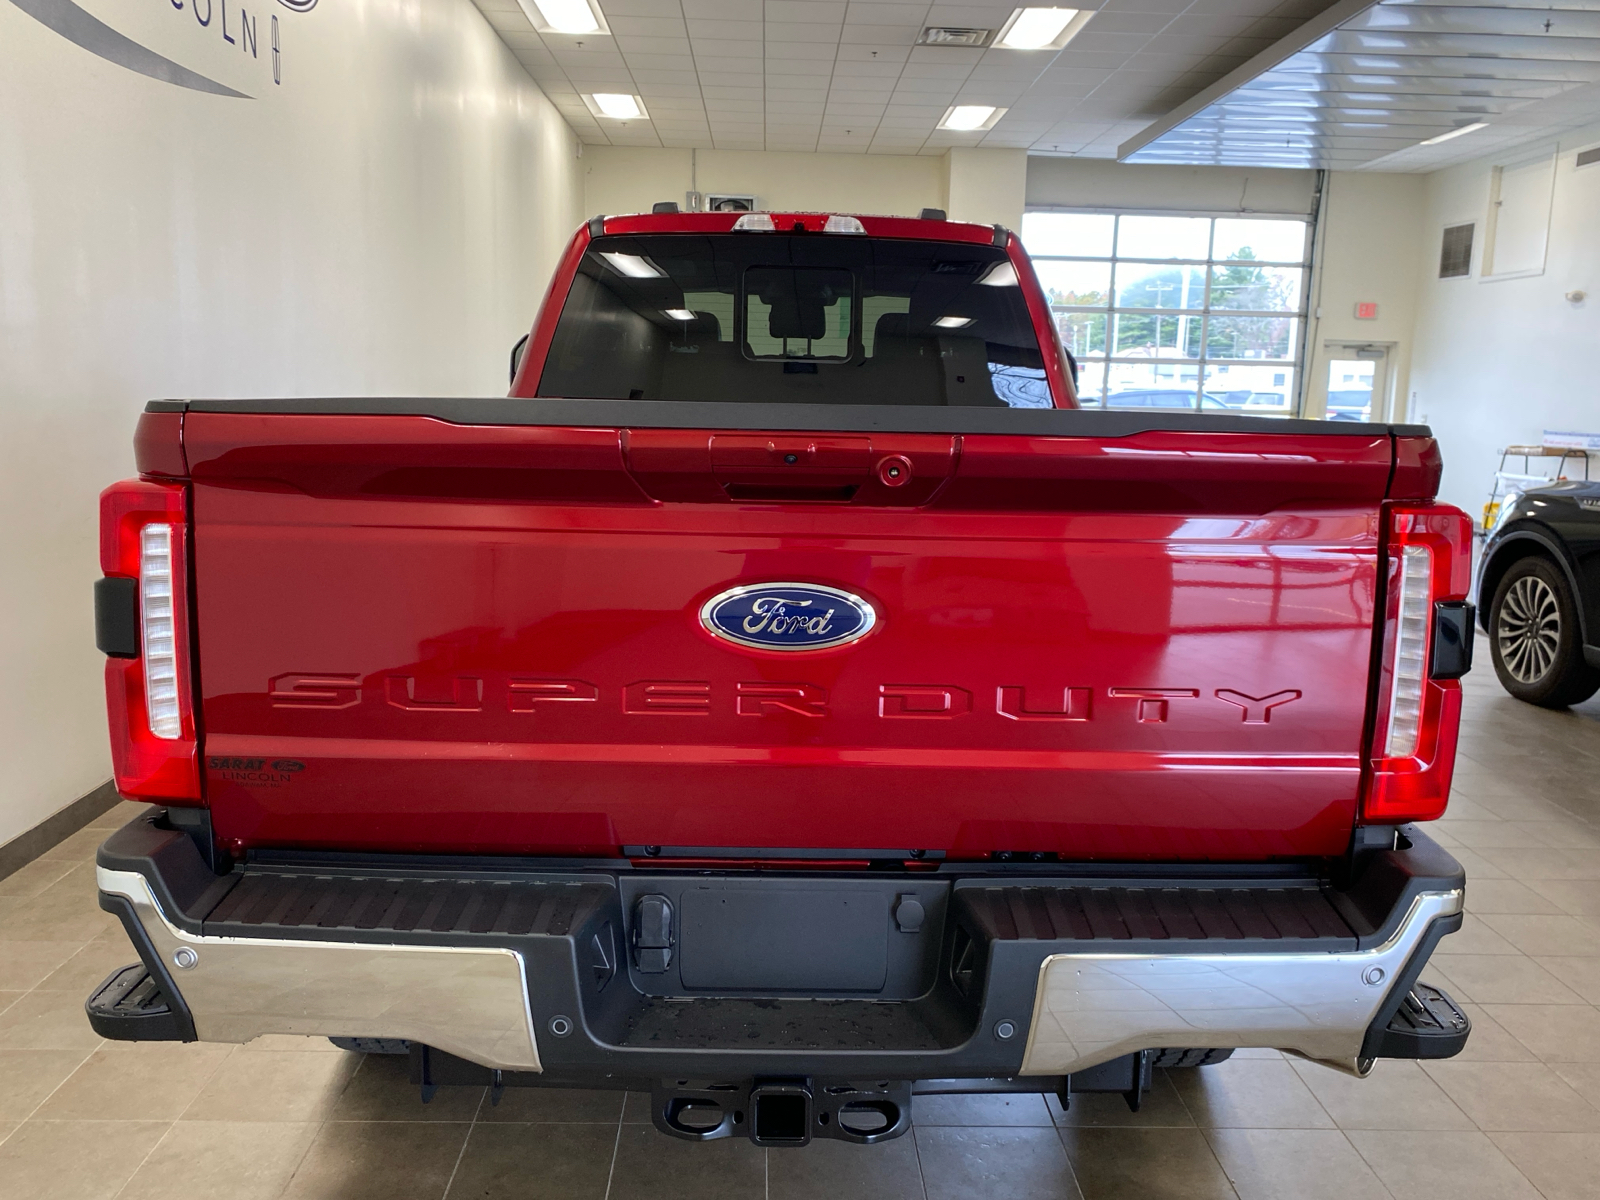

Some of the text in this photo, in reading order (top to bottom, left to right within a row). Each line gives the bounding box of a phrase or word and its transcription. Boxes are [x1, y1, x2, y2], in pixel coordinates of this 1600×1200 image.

[170, 0, 258, 59] OLN
[743, 597, 835, 635] Ford
[268, 671, 1303, 725] SUPER DUTY
[209, 757, 266, 769] SARAT
[222, 771, 291, 782] LINCOLN
